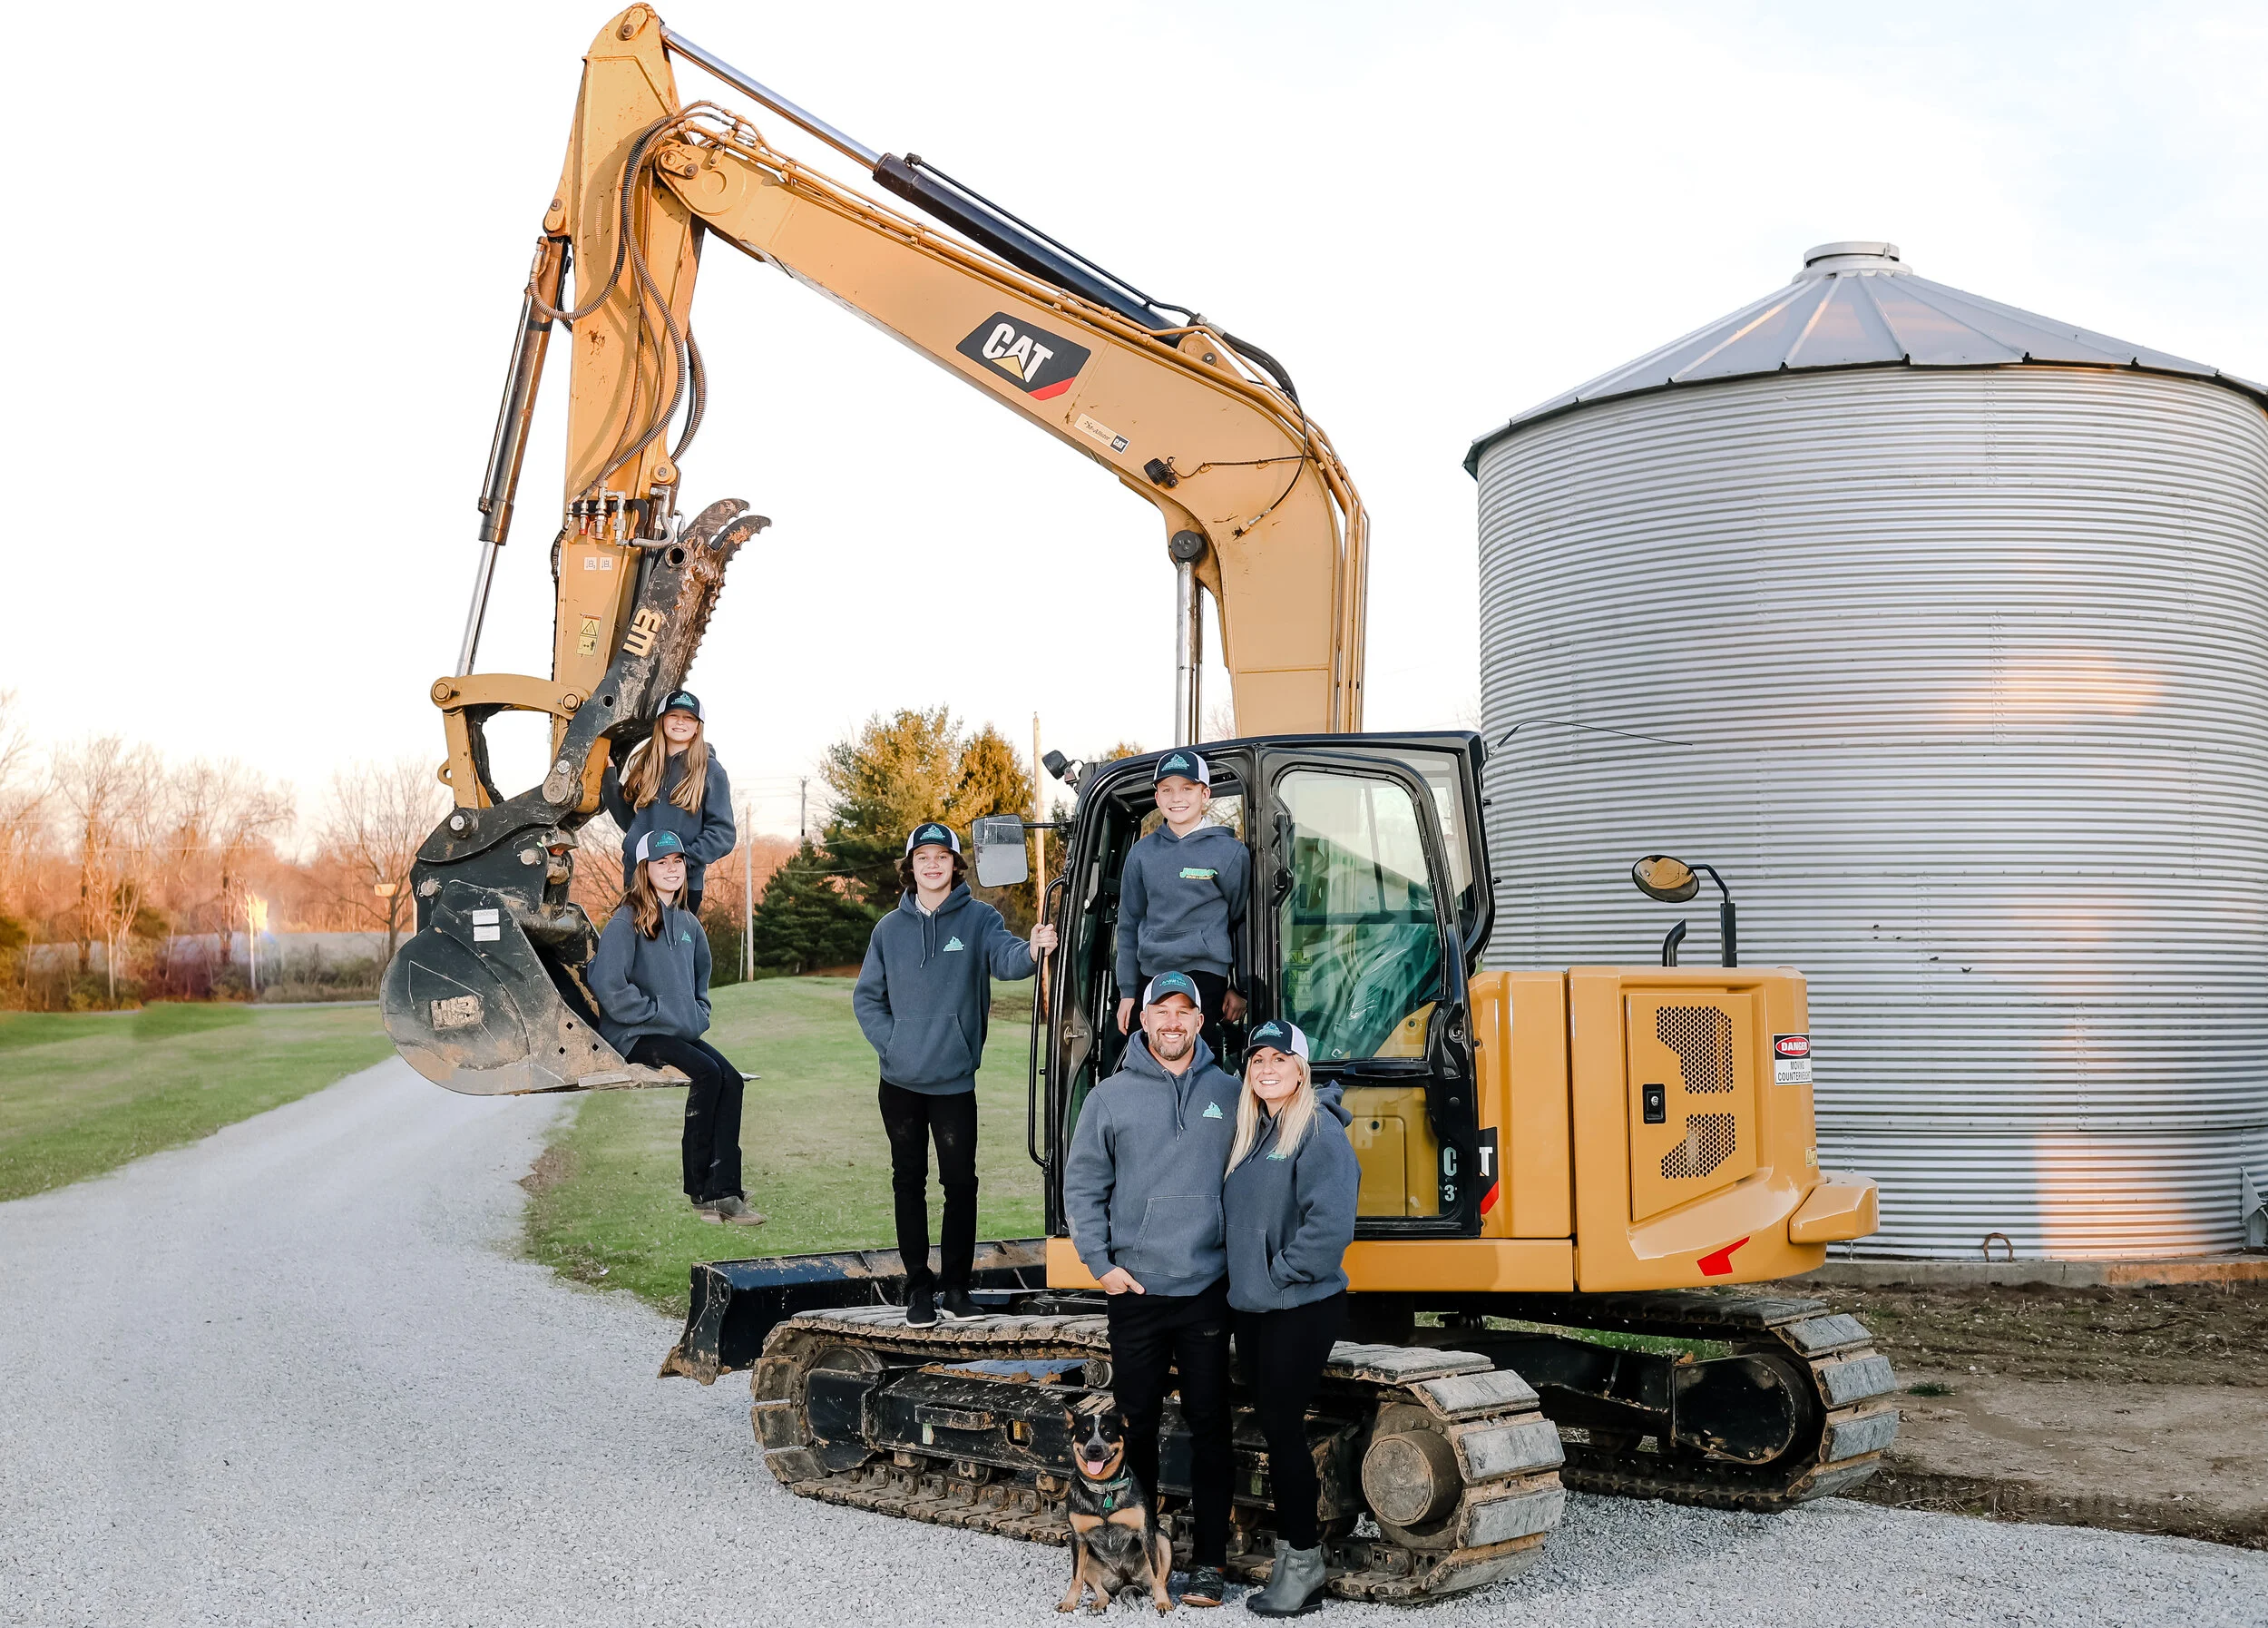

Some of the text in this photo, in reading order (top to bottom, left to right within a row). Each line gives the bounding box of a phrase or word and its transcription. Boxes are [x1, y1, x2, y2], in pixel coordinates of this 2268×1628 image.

[982, 322, 1054, 383] CAT
[1112, 437, 1126, 449] CAT
[1781, 1041, 1808, 1052] DANGER
[1443, 1146, 1493, 1177] CT
